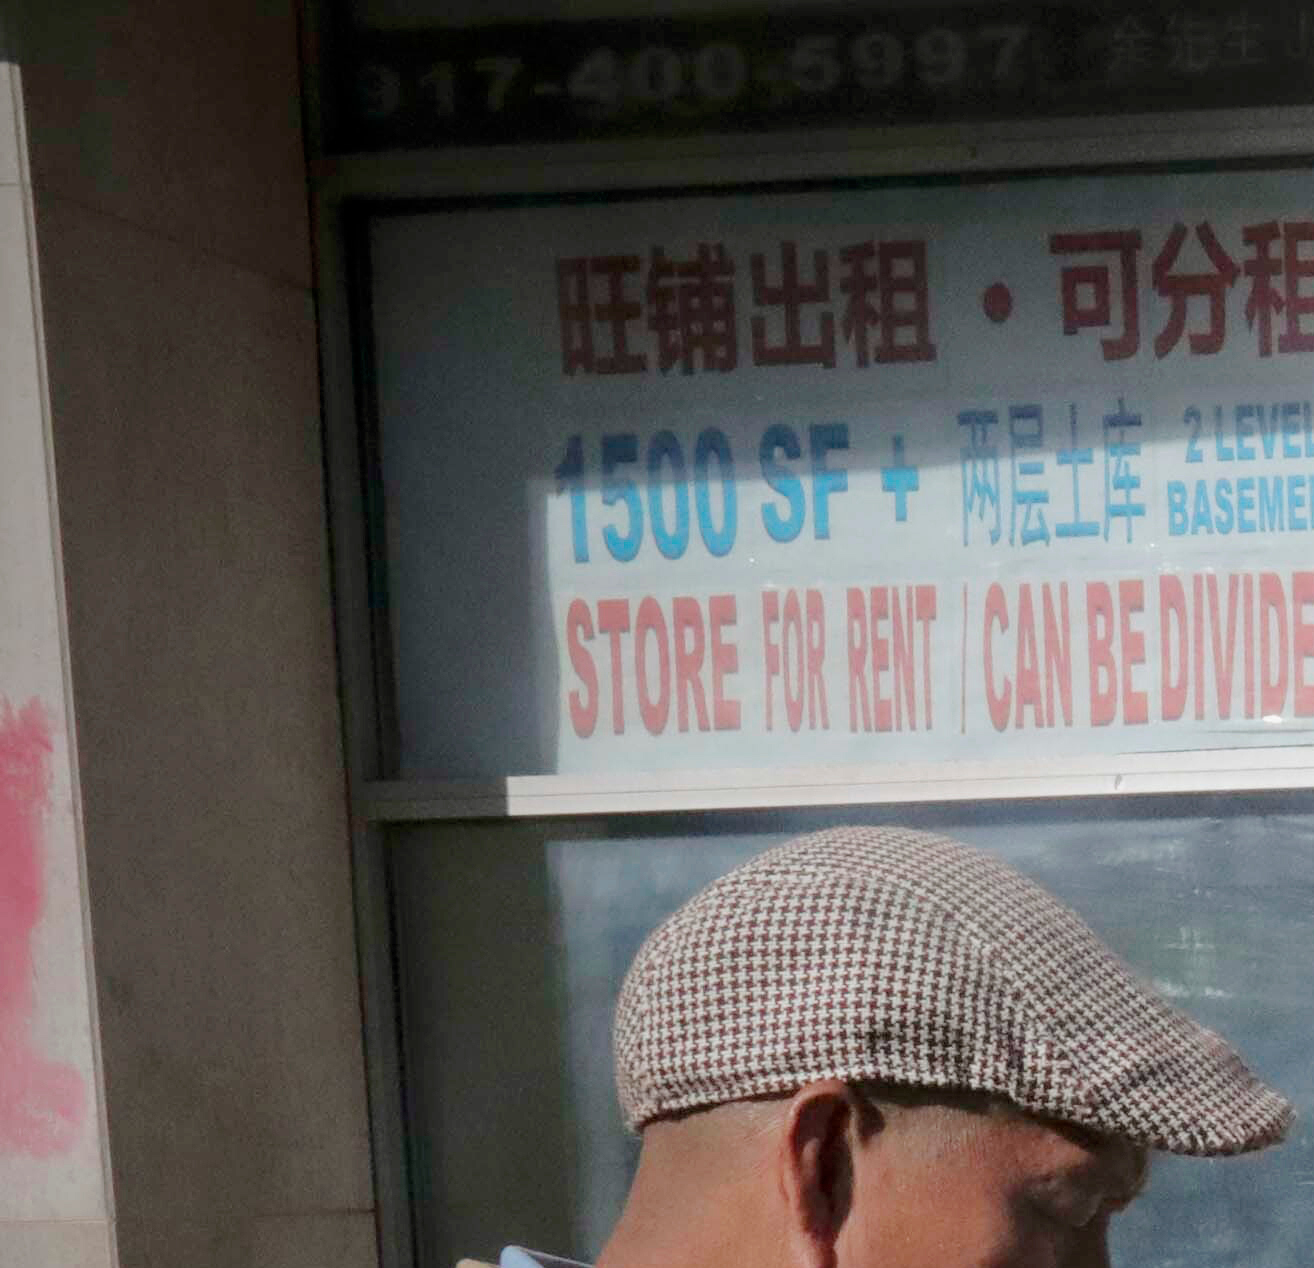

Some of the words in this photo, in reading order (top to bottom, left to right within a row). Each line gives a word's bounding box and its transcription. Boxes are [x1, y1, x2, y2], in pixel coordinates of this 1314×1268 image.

[556, 426, 737, 565] 1500
[760, 422, 850, 543] SF
[1184, 410, 1203, 464] 2
[566, 594, 742, 739] STORE
[763, 589, 829, 734] FOR
[847, 584, 938, 735] RENT
[983, 580, 1076, 732] CAN
[1088, 577, 1148, 727] BE
